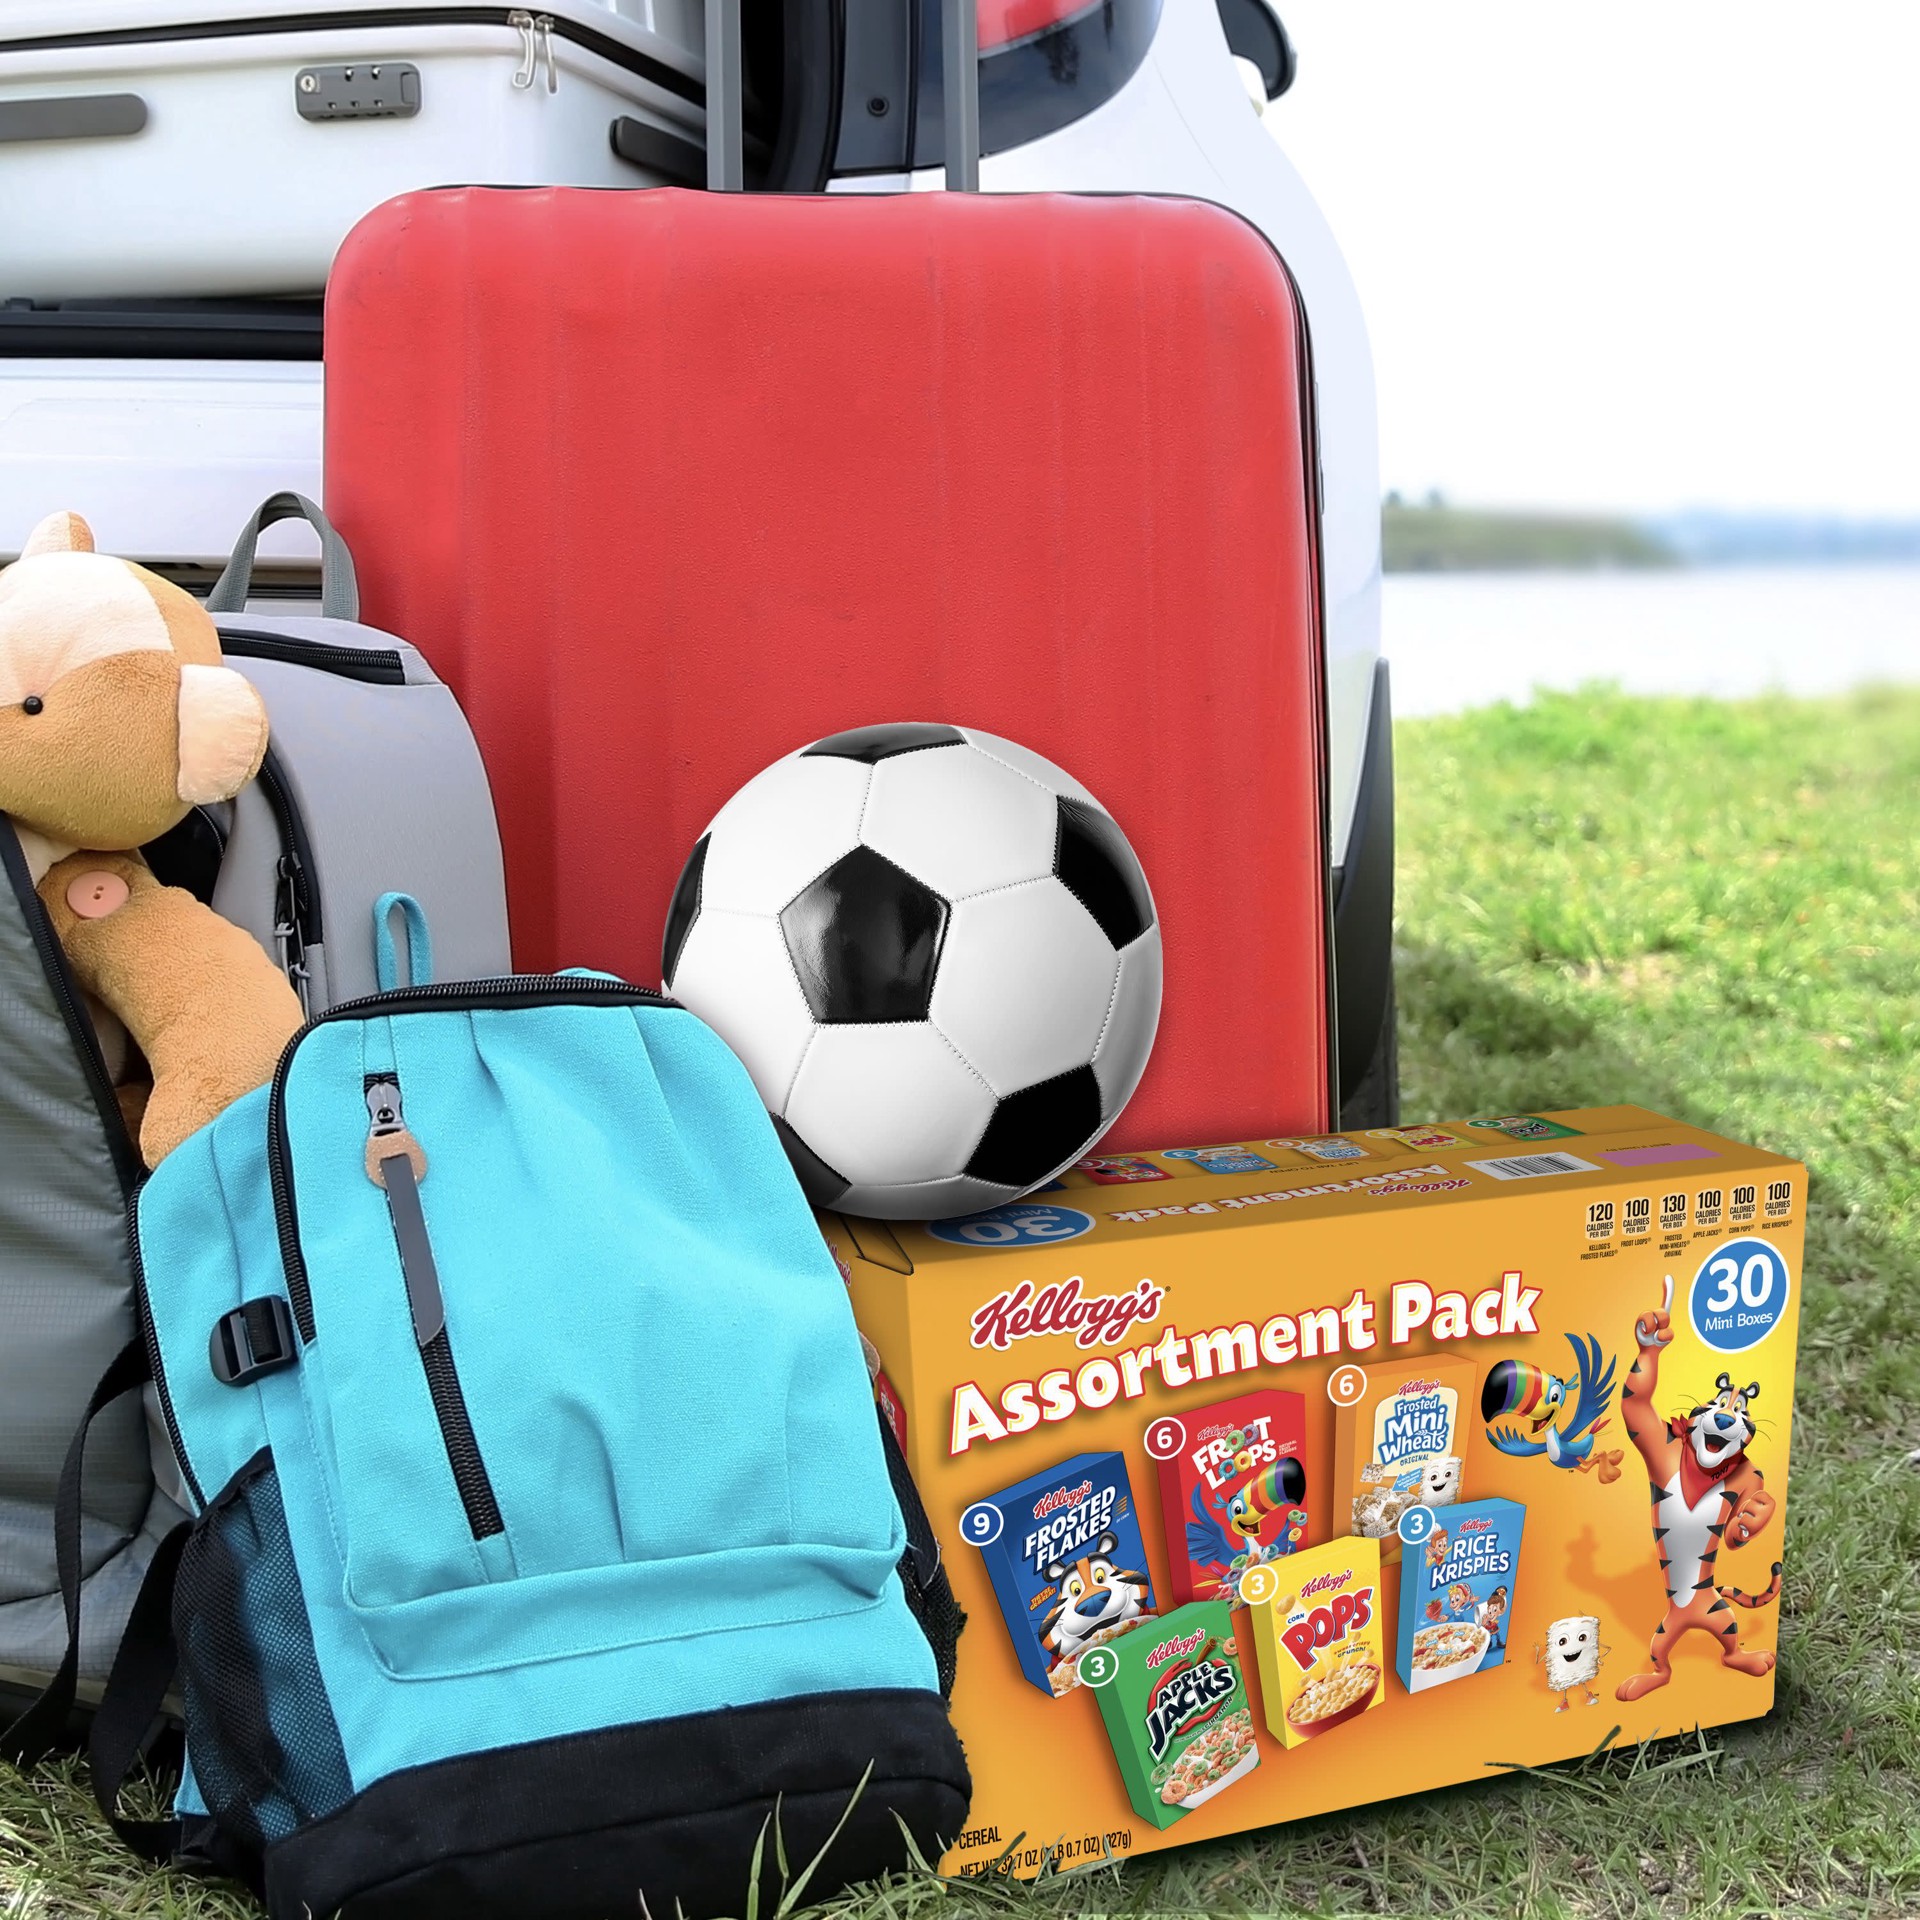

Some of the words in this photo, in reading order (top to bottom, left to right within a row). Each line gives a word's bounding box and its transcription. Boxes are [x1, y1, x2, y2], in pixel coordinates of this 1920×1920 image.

[1223, 1163, 1452, 1209] Assortment
[1368, 1178, 1473, 1196] Kellogg's
[1733, 1186, 1755, 1205] 100
[1768, 1182, 1790, 1201] 100
[1625, 1198, 1649, 1218] 100
[1662, 1195, 1685, 1213] 130
[1698, 1190, 1721, 1209] 100
[1730, 1204, 1755, 1214] CALORIES
[1765, 1200, 1790, 1210] CALORIES
[1108, 1202, 1220, 1223] Pack
[1589, 1203, 1613, 1222] 120
[1623, 1217, 1650, 1227] CALORIES
[1660, 1213, 1686, 1223] CALORIES
[1695, 1209, 1721, 1219] CALORIES
[959, 1215, 1075, 1242] 30
[1586, 1221, 1613, 1232] CALORIES
[1581, 1252, 1599, 1260] FROSTED
[1707, 1253, 1773, 1313] 30
[970, 1278, 1166, 1350] Kellogg's
[1705, 1315, 1733, 1332] Mini
[1737, 1312, 1773, 1328] Boxes
[950, 1289, 1378, 1457] Assortment
[1389, 1271, 1543, 1345] Pack
[1339, 1374, 1355, 1396] 6
[1398, 1378, 1440, 1396] Kellogg's
[1396, 1397, 1438, 1417] Frosted
[1197, 1423, 1234, 1441] Kellogg's
[1387, 1407, 1445, 1443] Mini
[1156, 1427, 1173, 1449] 6
[1191, 1416, 1272, 1475] FROOT
[1380, 1428, 1447, 1463] Wheats
[1205, 1440, 1277, 1490] LOOPS
[1400, 1454, 1429, 1466] ORIGINAL
[1711, 1464, 1730, 1481] TONY
[1033, 1480, 1092, 1520] Kellogg's
[973, 1513, 990, 1535] 9
[1024, 1486, 1116, 1557] FROSTED
[1410, 1514, 1424, 1535] 3
[1459, 1518, 1493, 1534] Kellogg's
[1035, 1508, 1112, 1572] FLAKES
[1453, 1534, 1498, 1560] RICE
[1431, 1553, 1510, 1589] KRISPIES
[1251, 1574, 1265, 1595] 3
[1301, 1569, 1353, 1598] Kellogg's
[1287, 1613, 1305, 1624] CORN
[1281, 1588, 1373, 1671] POPS
[1146, 1628, 1205, 1669] Kellogg's
[1090, 1656, 1106, 1678] 3
[1158, 1662, 1212, 1708] APPLE
[1148, 1667, 1233, 1758] JACKS
[959, 1826, 1002, 1850] CEREAL
[1025, 1849, 1038, 1867] OZ
[1066, 1840, 1081, 1858] 0.7
[1084, 1836, 1100, 1856] OZ)
